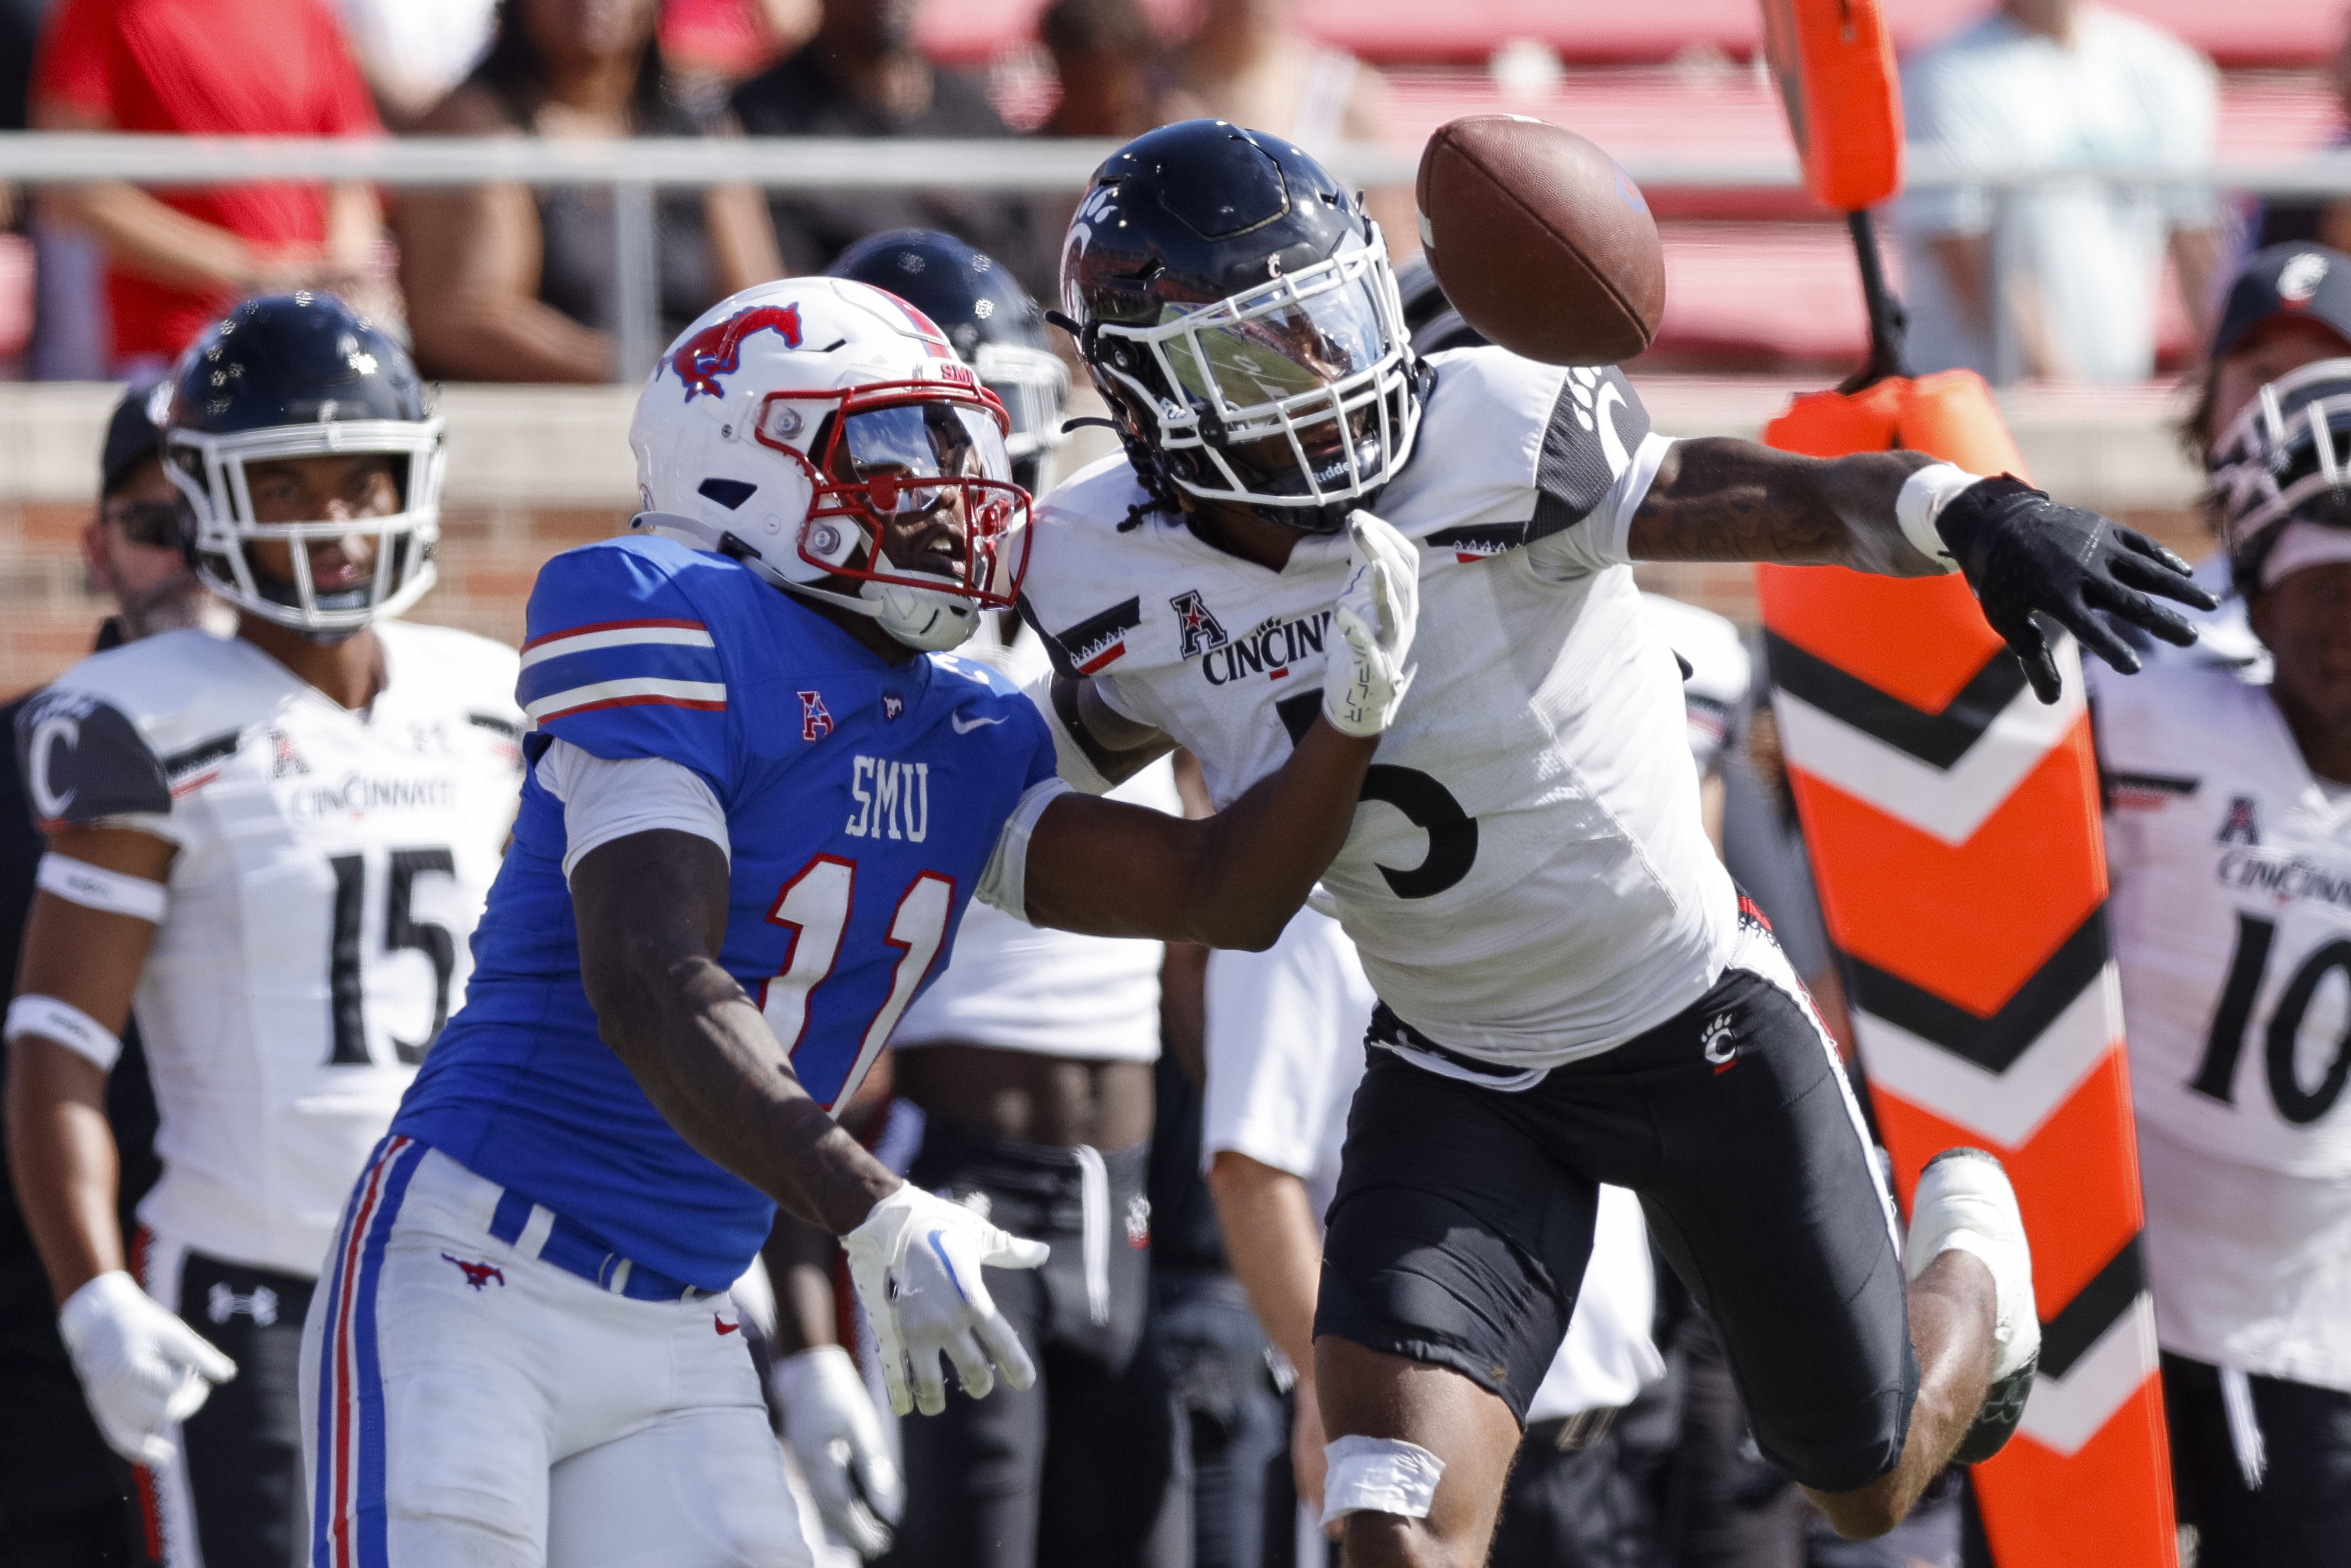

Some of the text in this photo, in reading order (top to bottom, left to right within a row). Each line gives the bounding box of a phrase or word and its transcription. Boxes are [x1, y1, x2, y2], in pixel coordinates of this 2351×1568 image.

[845, 755, 929, 843] SMU
[322, 845, 457, 1067] 15
[758, 851, 956, 1122] 11
[2186, 912, 2351, 1123] 10
